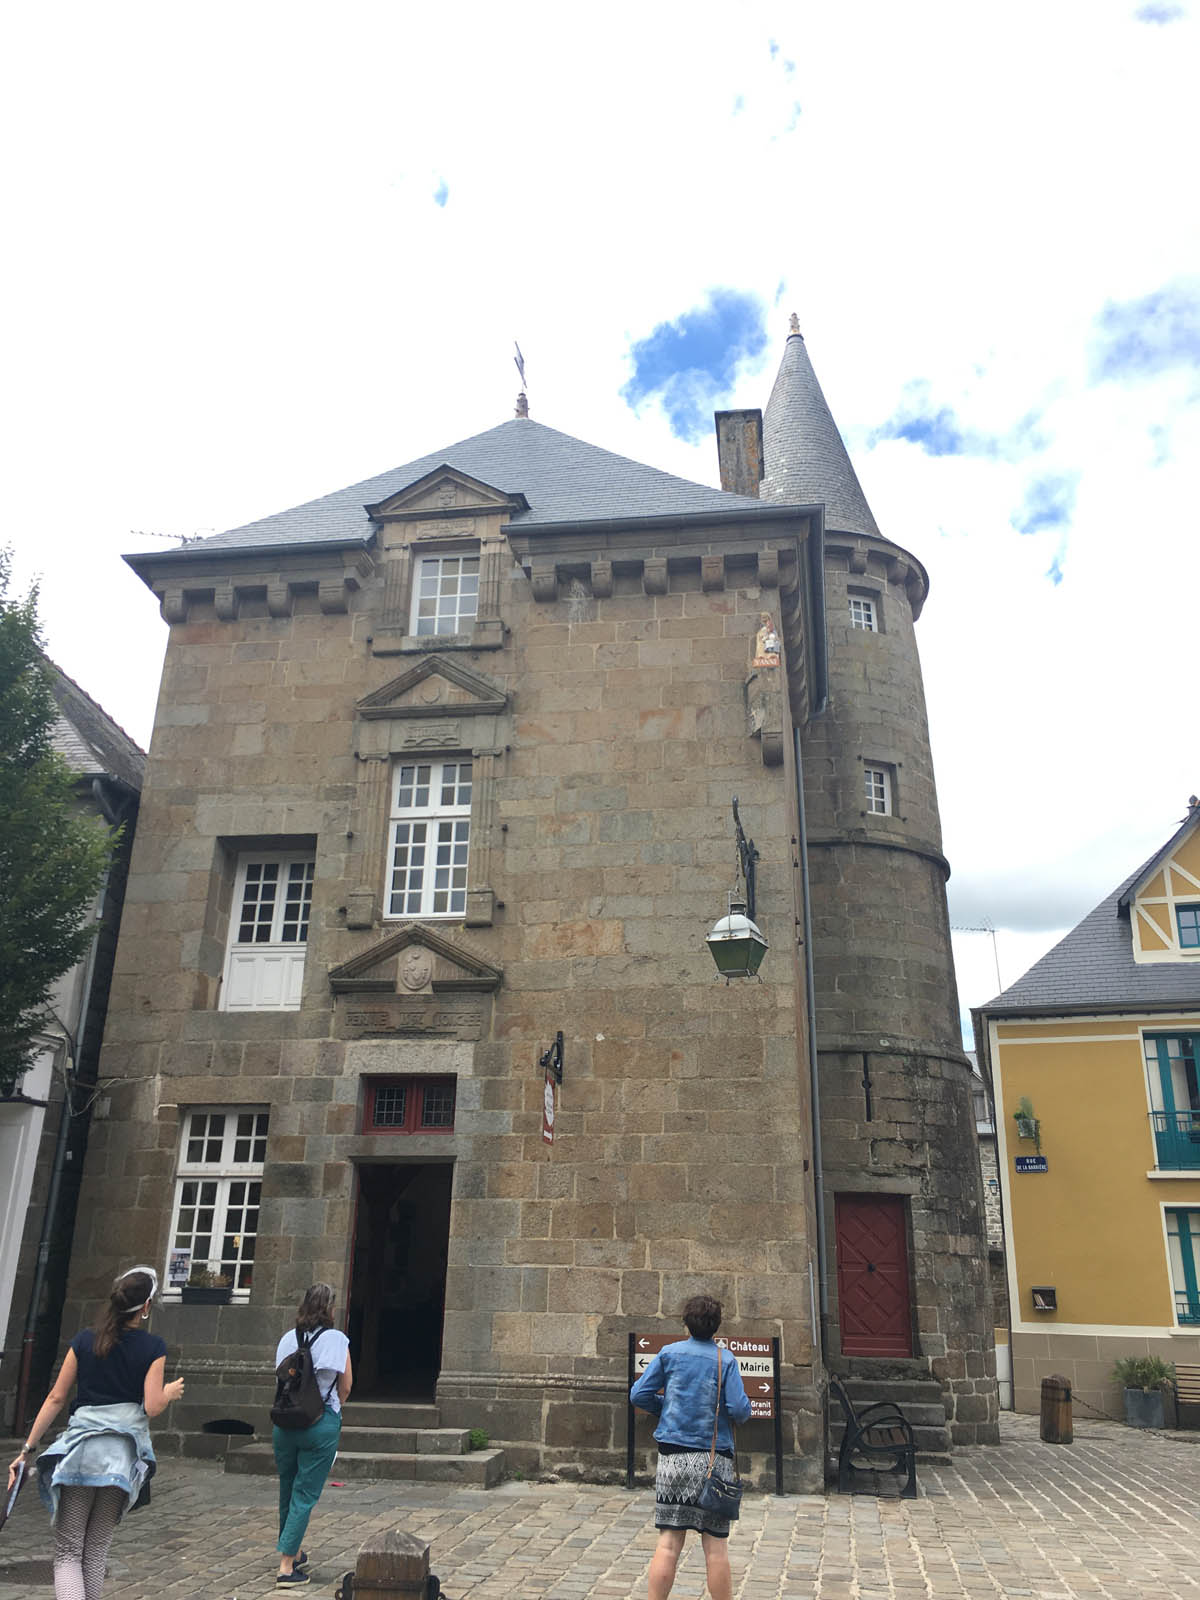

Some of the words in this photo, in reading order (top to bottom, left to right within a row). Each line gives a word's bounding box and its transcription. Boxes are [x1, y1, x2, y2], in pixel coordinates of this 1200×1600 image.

[730, 1341, 770, 1352] Château
[740, 1362, 770, 1372] Mairie
[750, 1400, 771, 1408] Granit
